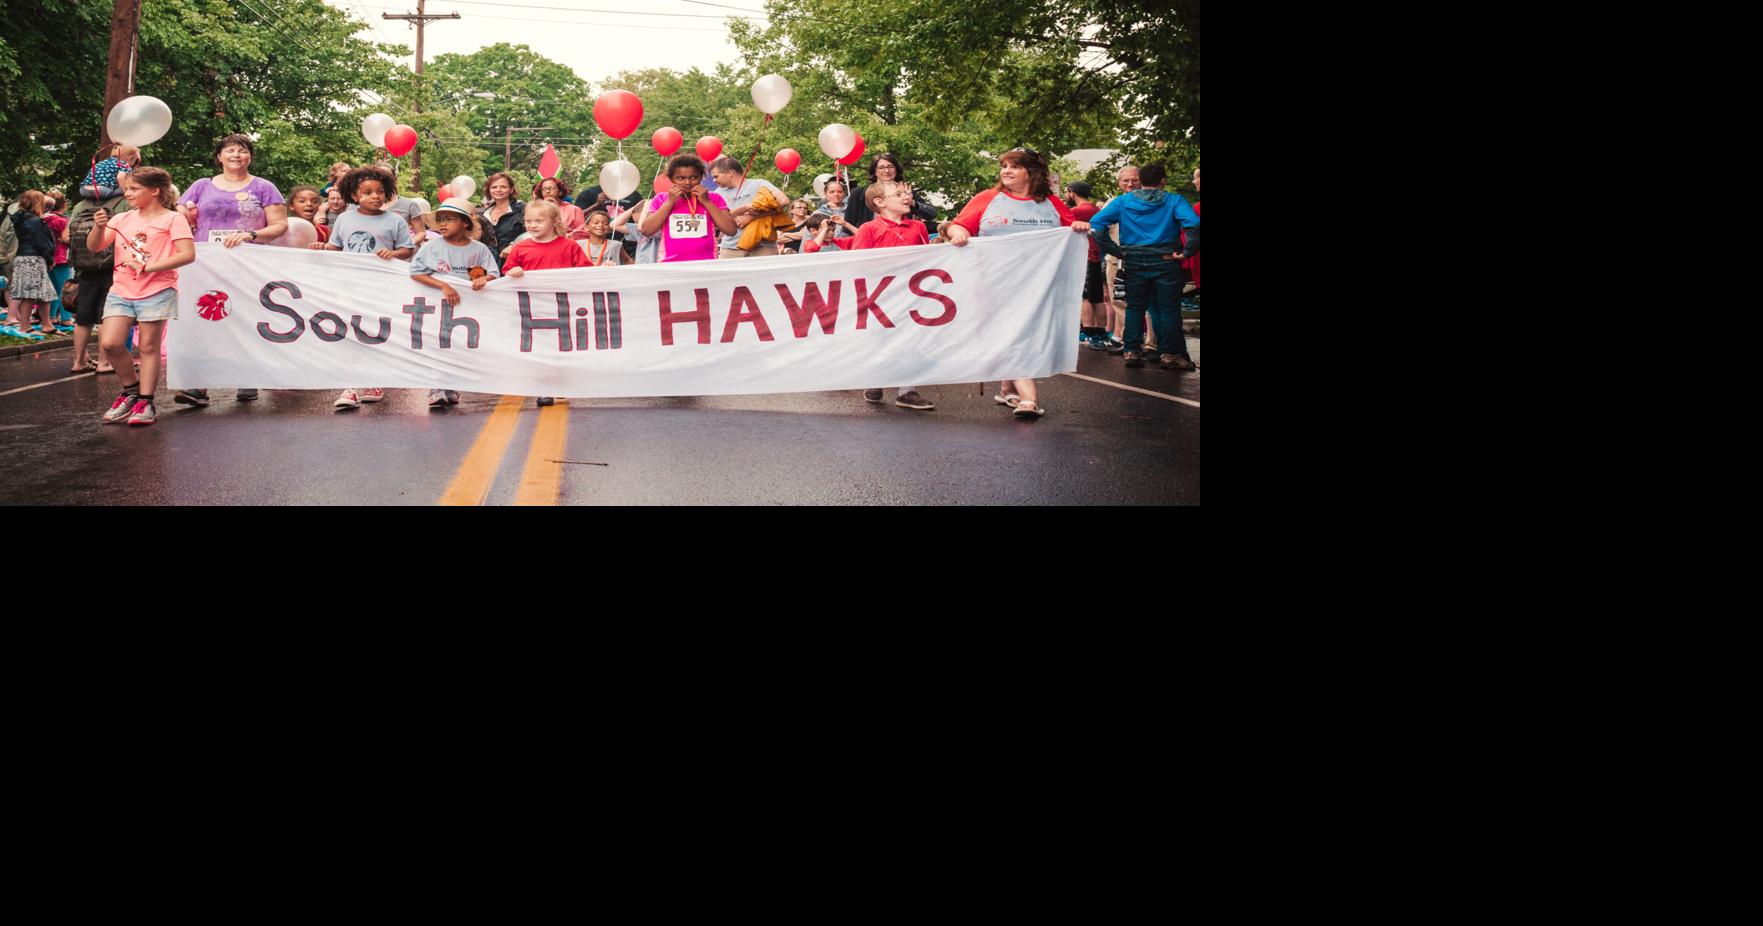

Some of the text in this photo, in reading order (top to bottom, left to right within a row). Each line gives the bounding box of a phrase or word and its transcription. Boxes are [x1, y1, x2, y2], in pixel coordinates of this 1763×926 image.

[256, 268, 957, 352] South Hill HAWKS
